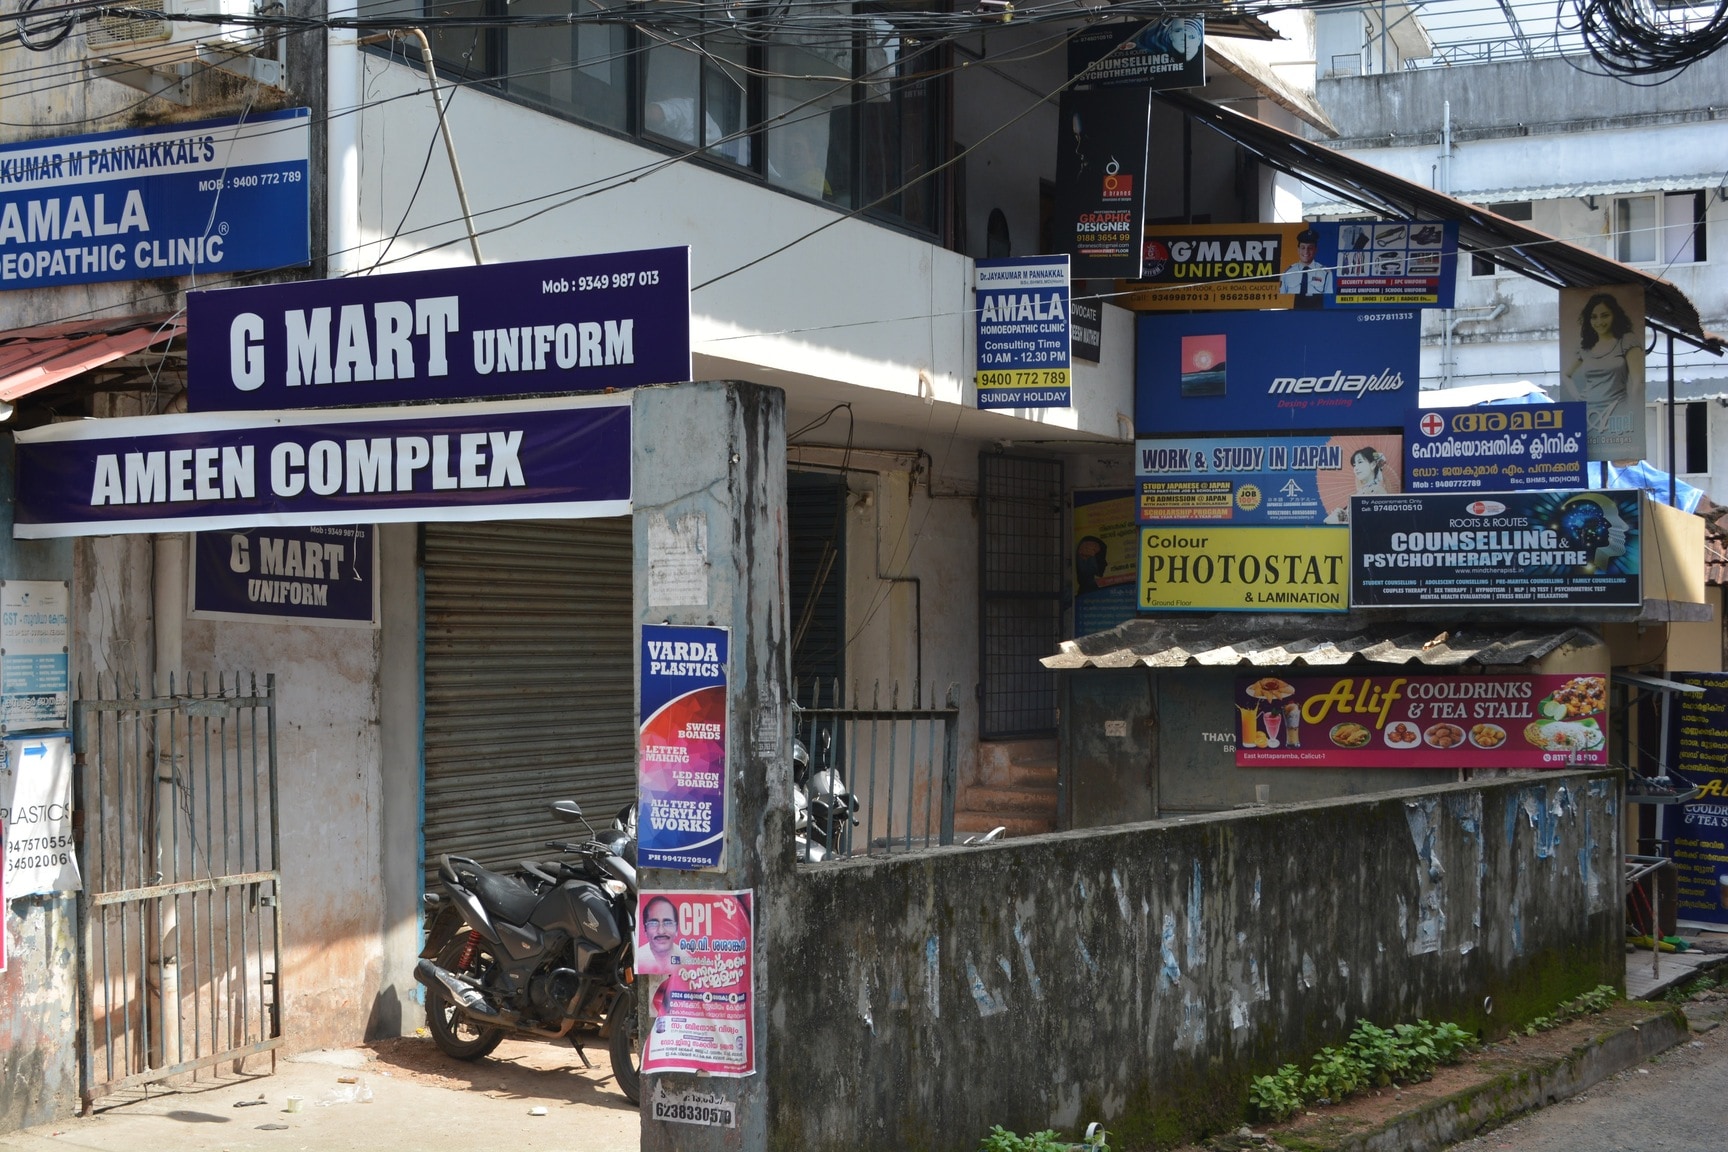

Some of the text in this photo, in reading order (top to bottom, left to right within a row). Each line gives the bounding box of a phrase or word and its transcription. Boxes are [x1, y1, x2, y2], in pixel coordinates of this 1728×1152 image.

[1150, 62, 1184, 74] CENTRE
[69, 151, 82, 178] M
[89, 135, 216, 175] PANNAKKAL'S
[198, 170, 301, 192] MOB 9400 772 789
[0, 189, 150, 246] AMALA
[1080, 213, 1132, 223] GRAPHIC
[1076, 222, 1131, 232] DESIGNER
[1076, 233, 1131, 242] 9188 3654 99
[0, 234, 225, 281] EOPATHIC CLINIC
[1022, 270, 1028, 279] M
[1029, 269, 1064, 279] PANNAKKAL
[1174, 262, 1274, 279] UNIFORM
[541, 270, 660, 295] Mob 9349 987 013
[981, 292, 1065, 323] AMALA
[1364, 312, 1413, 322] 9037811313
[980, 324, 1039, 335] HOMOEOPATHIC
[1040, 322, 1065, 334] CLINIC
[229, 295, 635, 392] G MART UNIFORM
[984, 339, 1061, 351] Consulting Time
[981, 351, 1066, 363] 10 AM 12.30 PM
[981, 371, 1066, 386] 9400 772 789
[981, 391, 1067, 403] SUNDAY HOLIDAY
[1317, 398, 1353, 408] Printing
[1451, 409, 1564, 433] അമല
[1142, 445, 1343, 472] WORK & STUDY IN JAPAN
[90, 430, 526, 506] AMEEN COMPLEX
[1413, 479, 1481, 489] Mob 9400772789
[1549, 476, 1580, 484] MD(HOM)
[1240, 490, 1257, 498] JOB
[1449, 517, 1528, 528] ROOTS ROUTES
[1147, 535, 1208, 549] Colour
[1391, 529, 1570, 552] COUNSELLING &
[230, 534, 345, 581] G MART
[1363, 550, 1588, 568] PSYCHOTHERAPY CENTRE
[1147, 554, 1344, 585] PHOTOSTAT
[248, 578, 329, 607] UNIFORM
[1244, 592, 1340, 604] & LAMINATION
[1151, 599, 1192, 607] Ground Floor
[3, 612, 18, 626] GST
[647, 640, 718, 662] VARDA
[650, 661, 719, 678] PLASTICS
[1406, 682, 1533, 700] COOLDRINKS
[1301, 678, 1408, 731] Alif
[1407, 702, 1534, 719] & TEA STALL
[686, 722, 721, 732] SWICH
[678, 730, 721, 740] BOARDS
[645, 745, 688, 755] LETTER
[1243, 752, 1257, 760] East
[1257, 752, 1300, 761] kottaparamba,
[645, 753, 690, 763] MAKING
[672, 771, 720, 781] LED SIGN
[677, 778, 720, 789] BOARDS
[650, 799, 712, 811] ALL TYPE OF
[650, 806, 712, 822] ACRYLIC
[650, 817, 711, 833] WORKS
[1697, 815, 1718, 827] TEA
[648, 854, 712, 865] PH 9947570554
[679, 901, 713, 937] CPI
